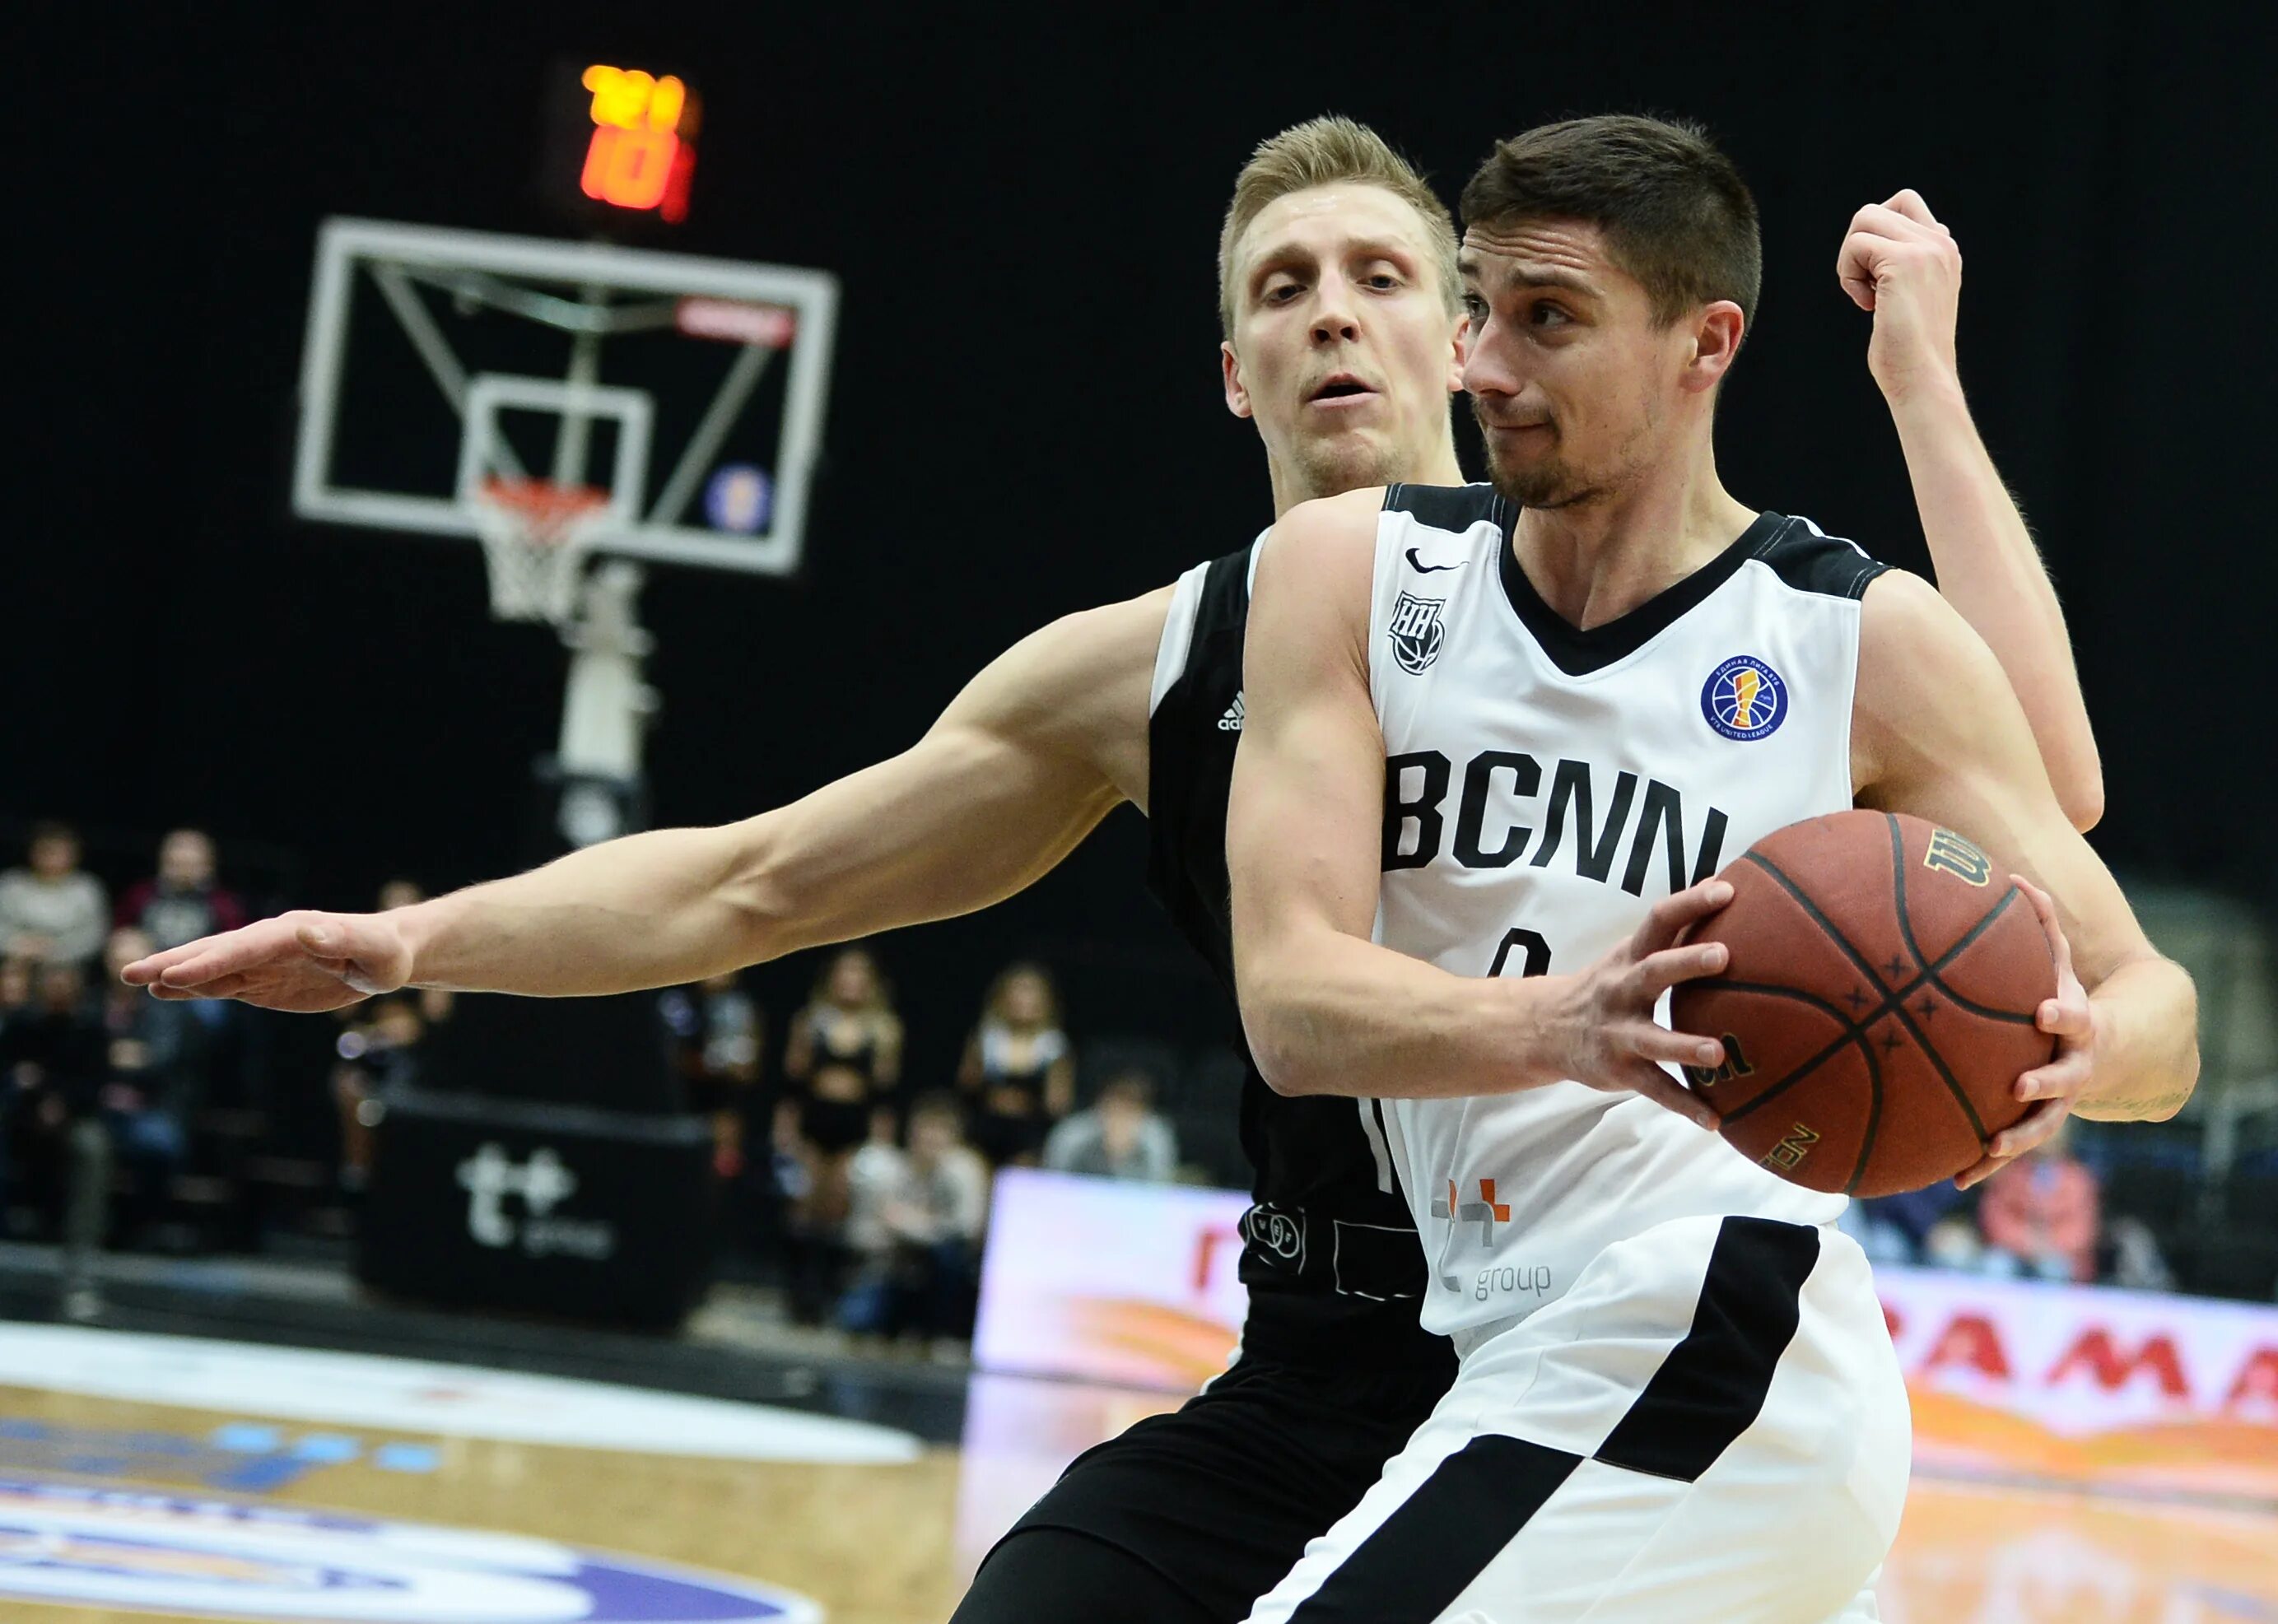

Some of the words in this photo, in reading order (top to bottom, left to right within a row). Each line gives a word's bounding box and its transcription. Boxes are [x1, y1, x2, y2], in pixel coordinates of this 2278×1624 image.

[1716, 658, 1748, 676] ЕДИНАЯ
[1749, 660, 1768, 675] ЛИГА
[1710, 715, 1721, 729] VTB
[1721, 728, 1747, 738] UNITED
[1748, 724, 1773, 738] LEAGUE
[1381, 750, 1728, 898] BCNN
[1475, 1266, 1550, 1301] group
